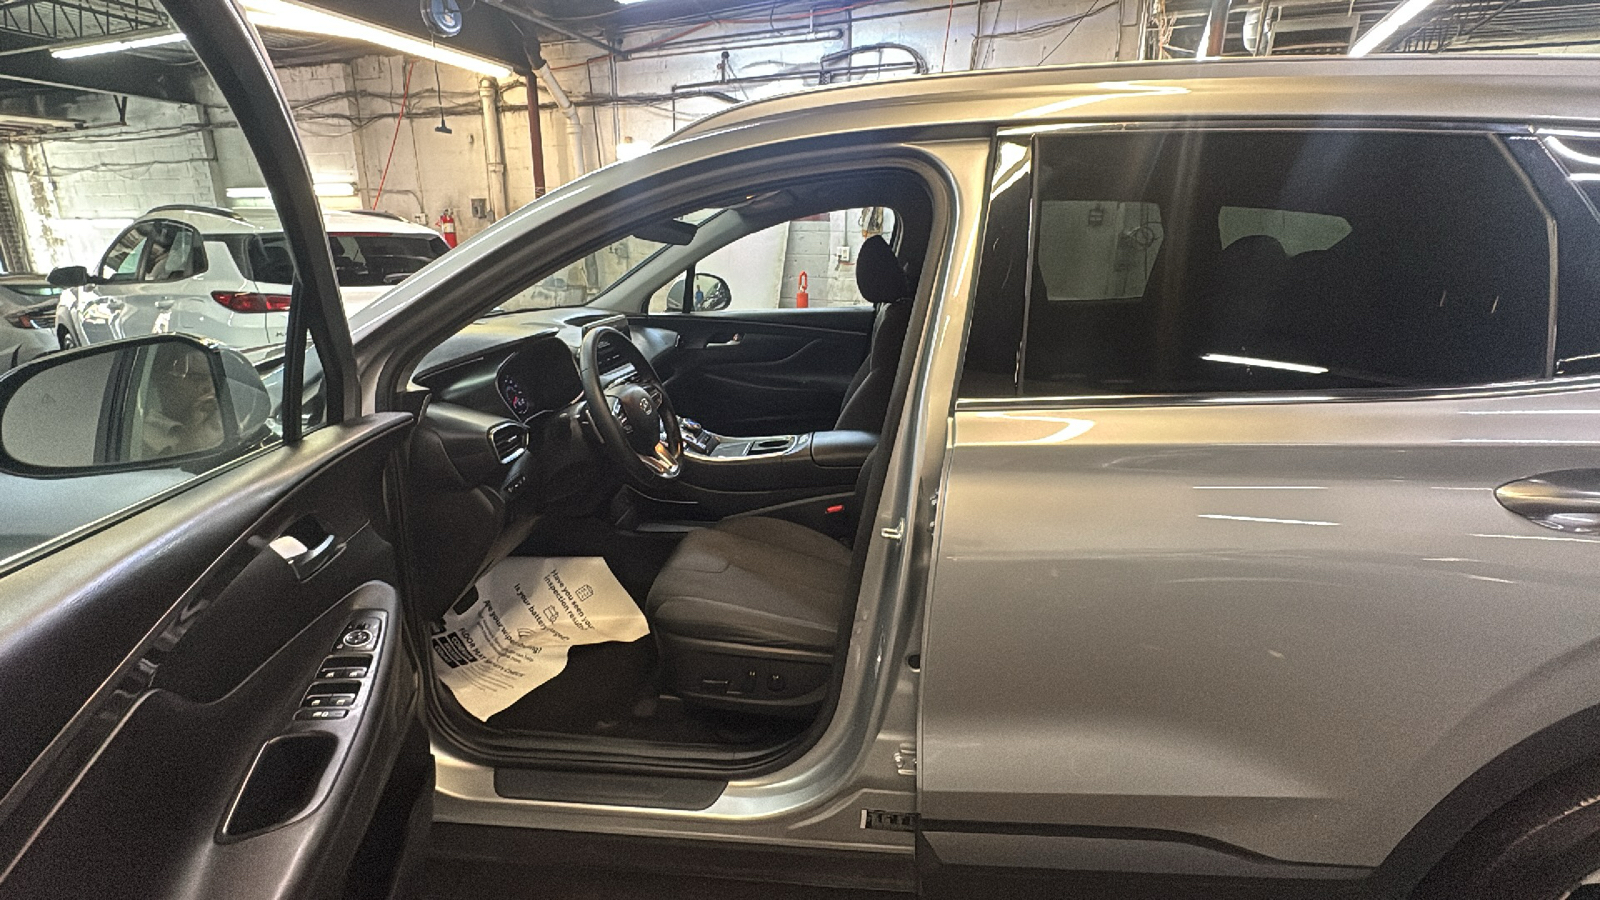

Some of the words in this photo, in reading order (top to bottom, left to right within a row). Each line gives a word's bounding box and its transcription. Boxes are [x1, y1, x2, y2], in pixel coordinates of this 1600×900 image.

[513, 583, 521, 592] Is
[516, 590, 531, 606] your
[543, 574, 569, 612] inspection
[550, 568, 564, 588] Have
[561, 587, 574, 601] you
[571, 600, 585, 617] seen
[489, 611, 503, 628] your
[528, 605, 547, 630] battery
